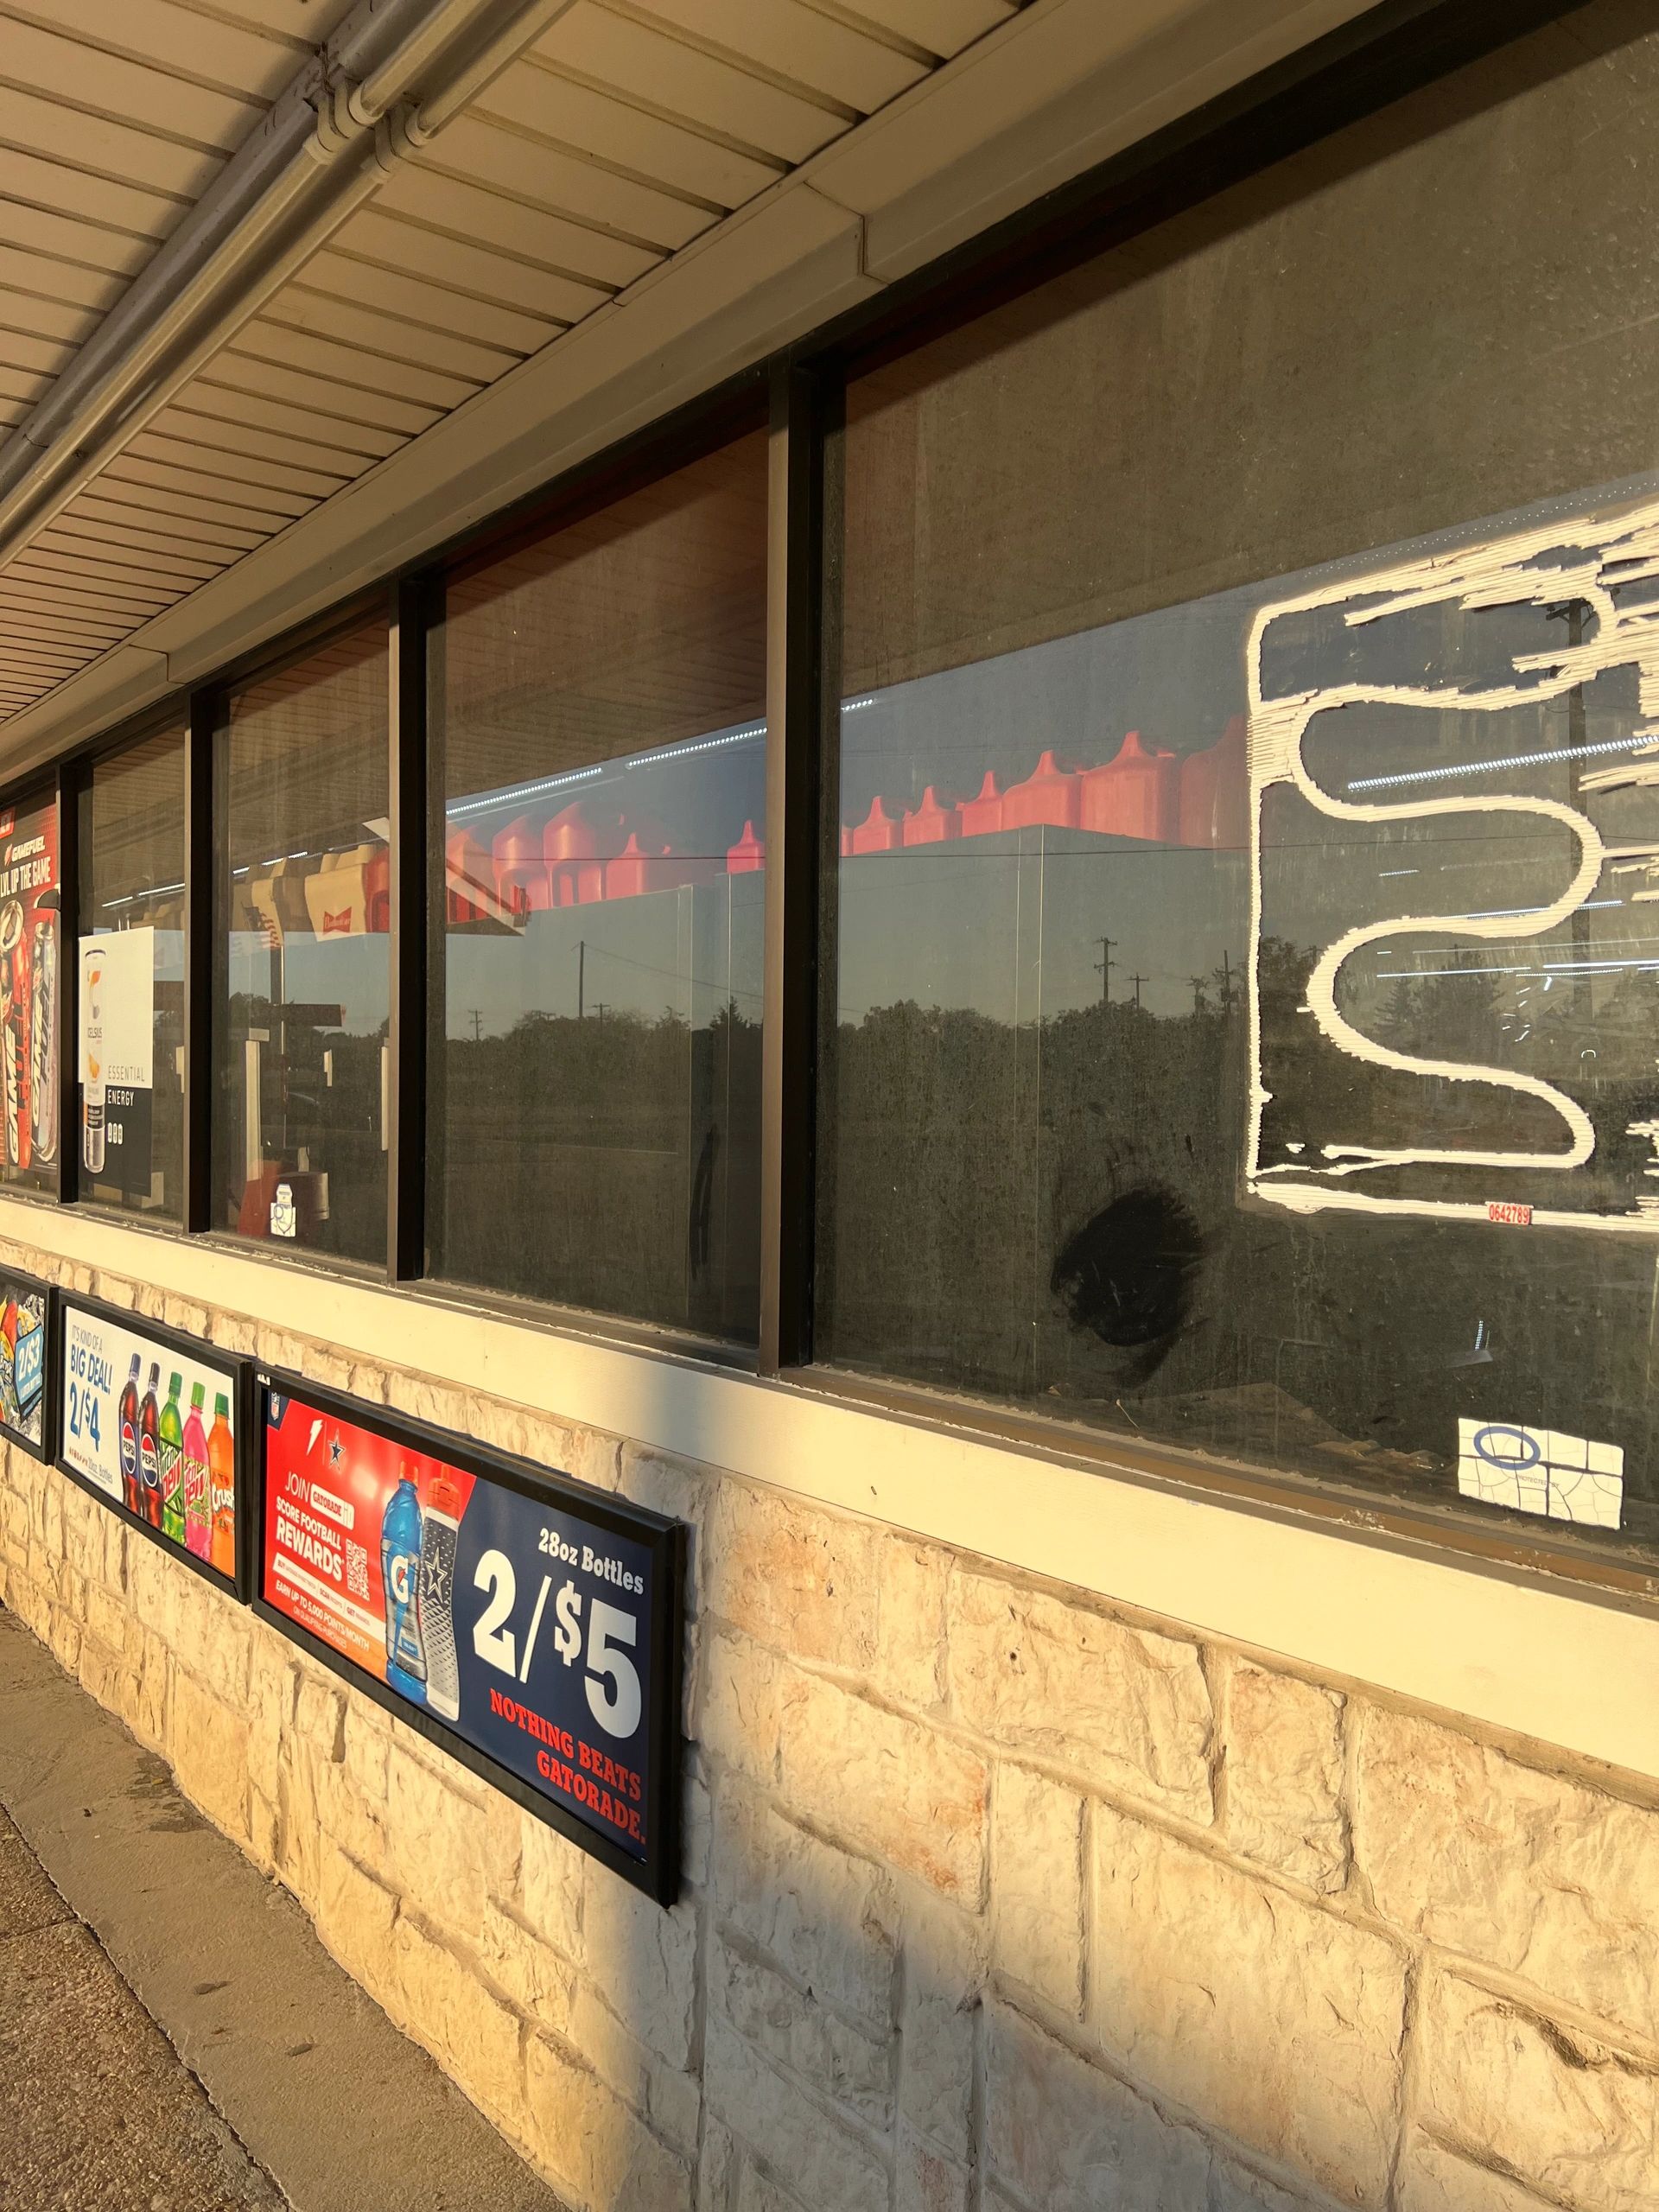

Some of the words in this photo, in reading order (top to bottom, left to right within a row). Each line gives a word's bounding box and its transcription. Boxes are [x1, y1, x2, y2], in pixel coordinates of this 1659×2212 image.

[11, 836, 45, 862] GAMEFUEL
[11, 868, 19, 894] UP
[20, 863, 32, 892] THE
[33, 856, 51, 887] GAME
[108, 1065, 144, 1082] ESSENTIAL
[107, 1089, 135, 1106] ENERGY
[18, 1333, 40, 1382] 2/$3
[92, 1334, 99, 1350] OF
[99, 1338, 103, 1354] A
[71, 1344, 86, 1379] BIG
[87, 1353, 112, 1395] DEAL!
[70, 1381, 100, 1452] 2/$4
[212, 1483, 235, 1512] Crush
[285, 1471, 310, 1503] JOIN
[313, 1491, 342, 1517] GATORADE
[276, 1496, 301, 1523] SCORE
[300, 1512, 342, 1551] FOOTBALL
[538, 1528, 578, 1566] 28oz
[582, 1545, 644, 1596] Bottles
[276, 1580, 291, 1599] EARN
[291, 1588, 300, 1603] UP
[300, 1594, 308, 1610] TO
[307, 1601, 324, 1621] 5,000
[473, 1548, 642, 1739] 2/$5
[490, 1688, 575, 1758] NOTHING
[577, 1739, 642, 1802] BEATS
[537, 1749, 646, 1845] GATORADE.
